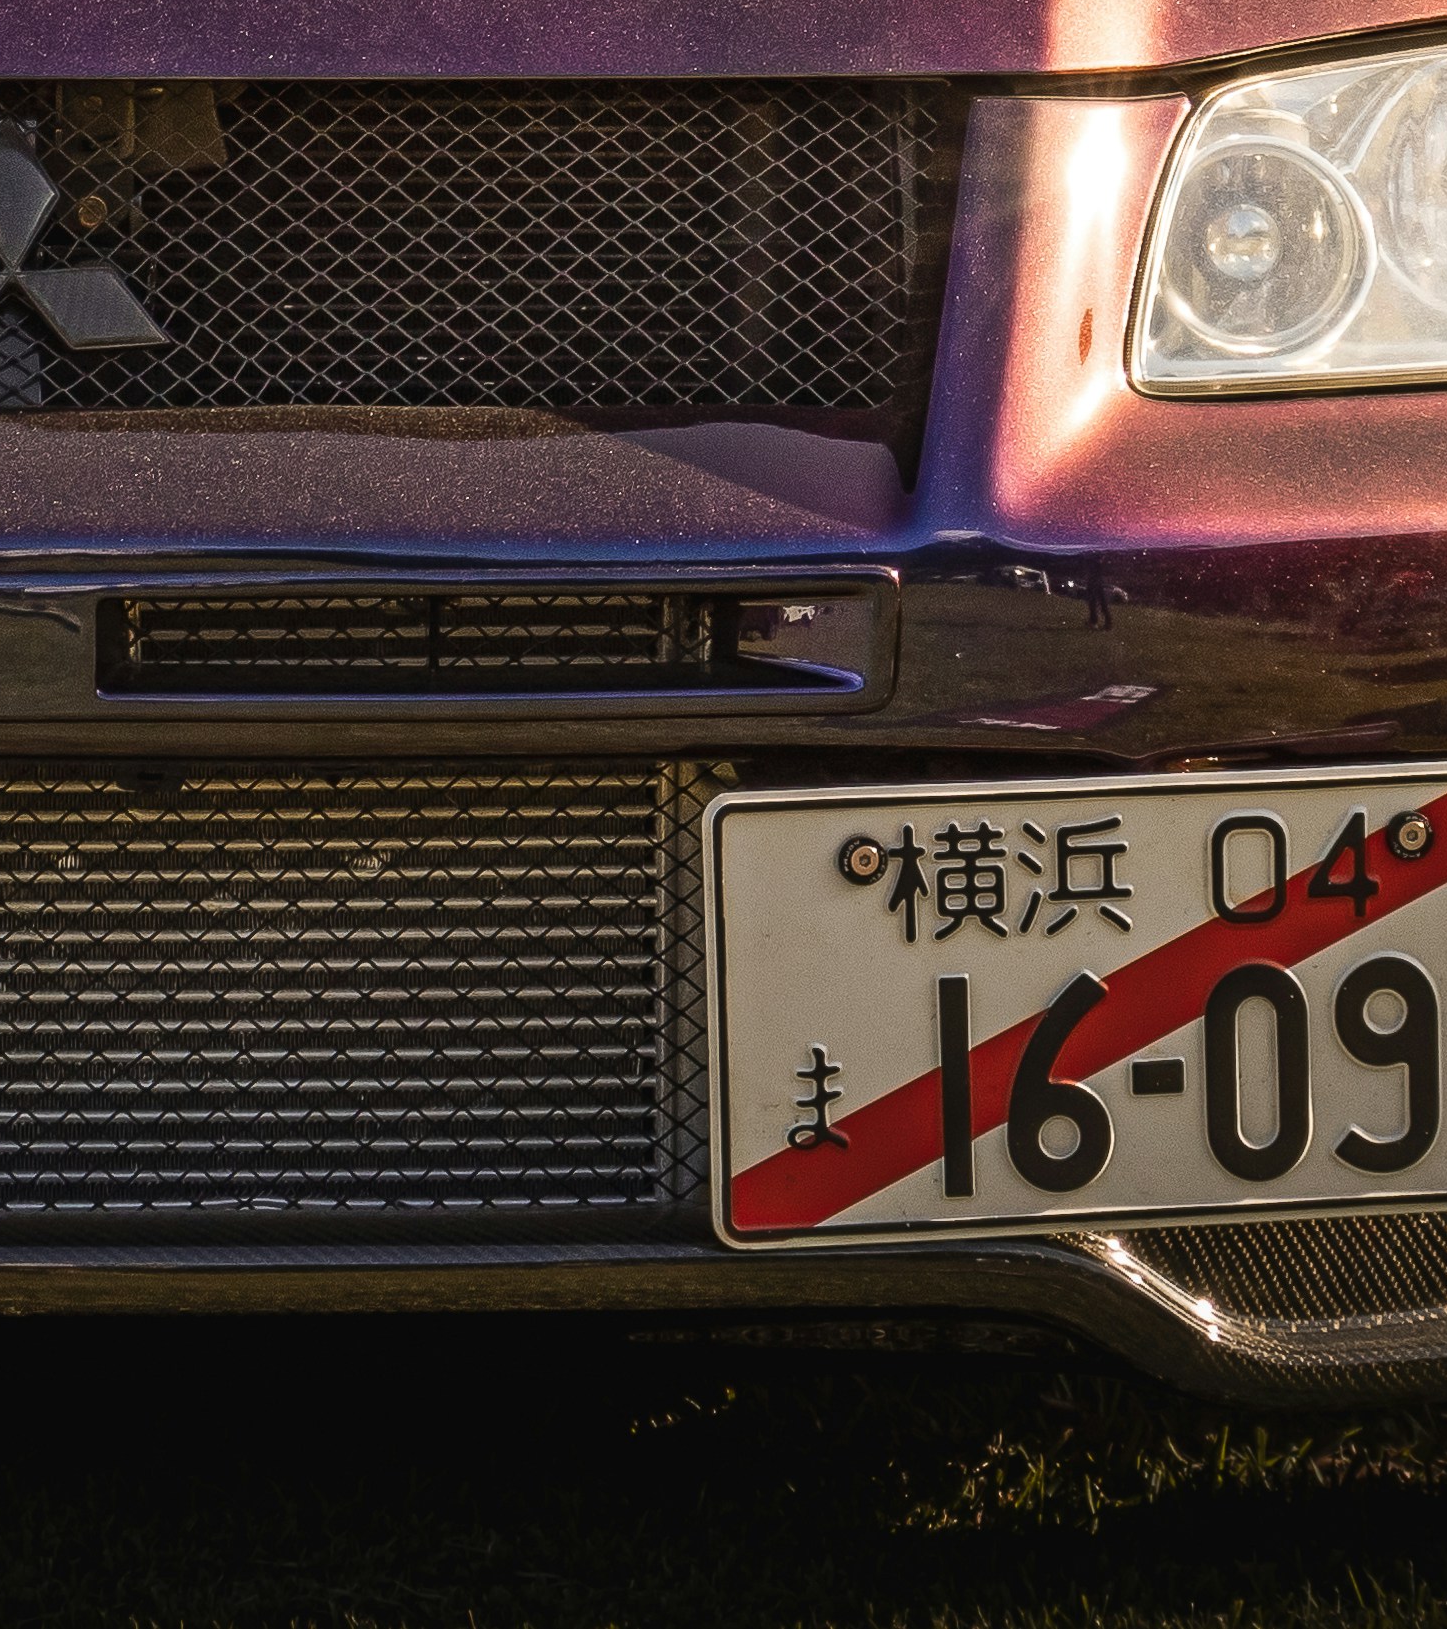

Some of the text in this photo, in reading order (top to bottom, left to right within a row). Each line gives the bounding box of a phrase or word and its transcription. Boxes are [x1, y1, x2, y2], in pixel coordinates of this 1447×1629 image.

[888, 807, 1380, 943] 横浜 04
[787, 951, 1443, 1200] ま 16-09
